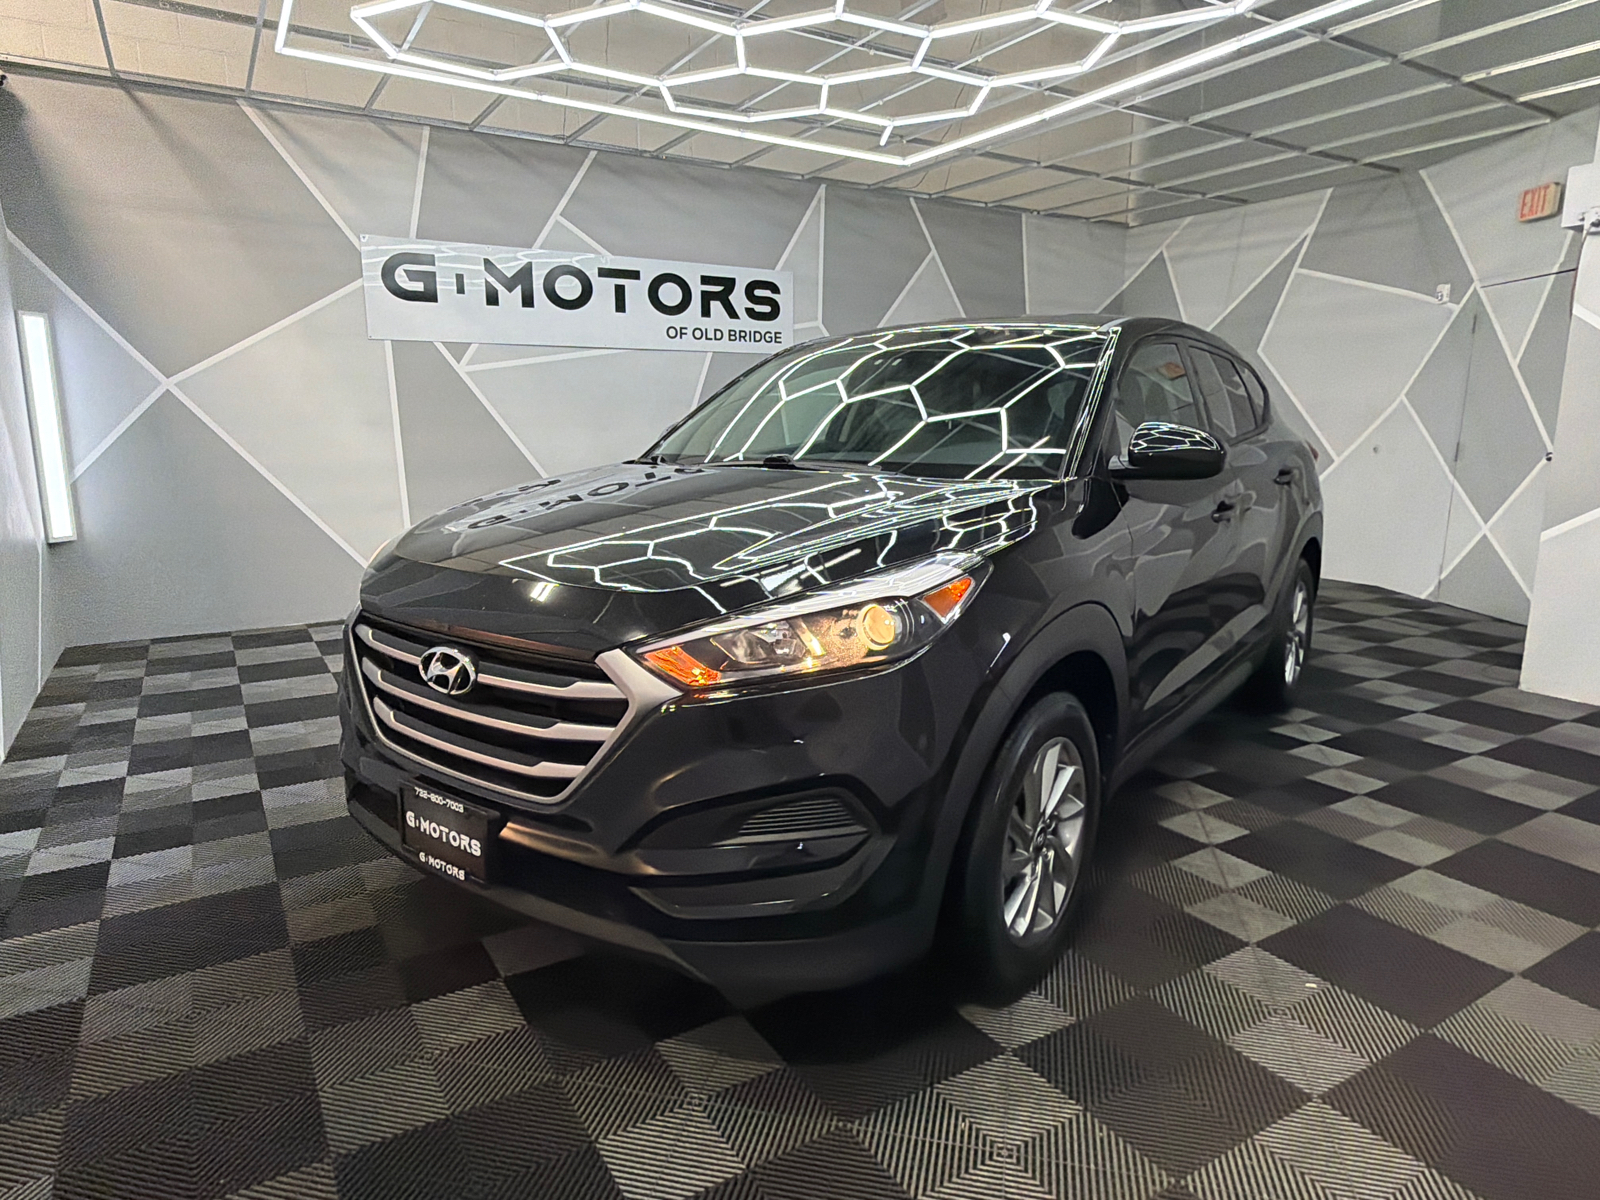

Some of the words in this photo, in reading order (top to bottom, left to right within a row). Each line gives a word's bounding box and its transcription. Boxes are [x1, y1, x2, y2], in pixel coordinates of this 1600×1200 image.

[1520, 184, 1550, 219] EXIT
[666, 326, 688, 340] OF
[692, 327, 724, 341] OLD
[728, 329, 783, 344] BRIDGE
